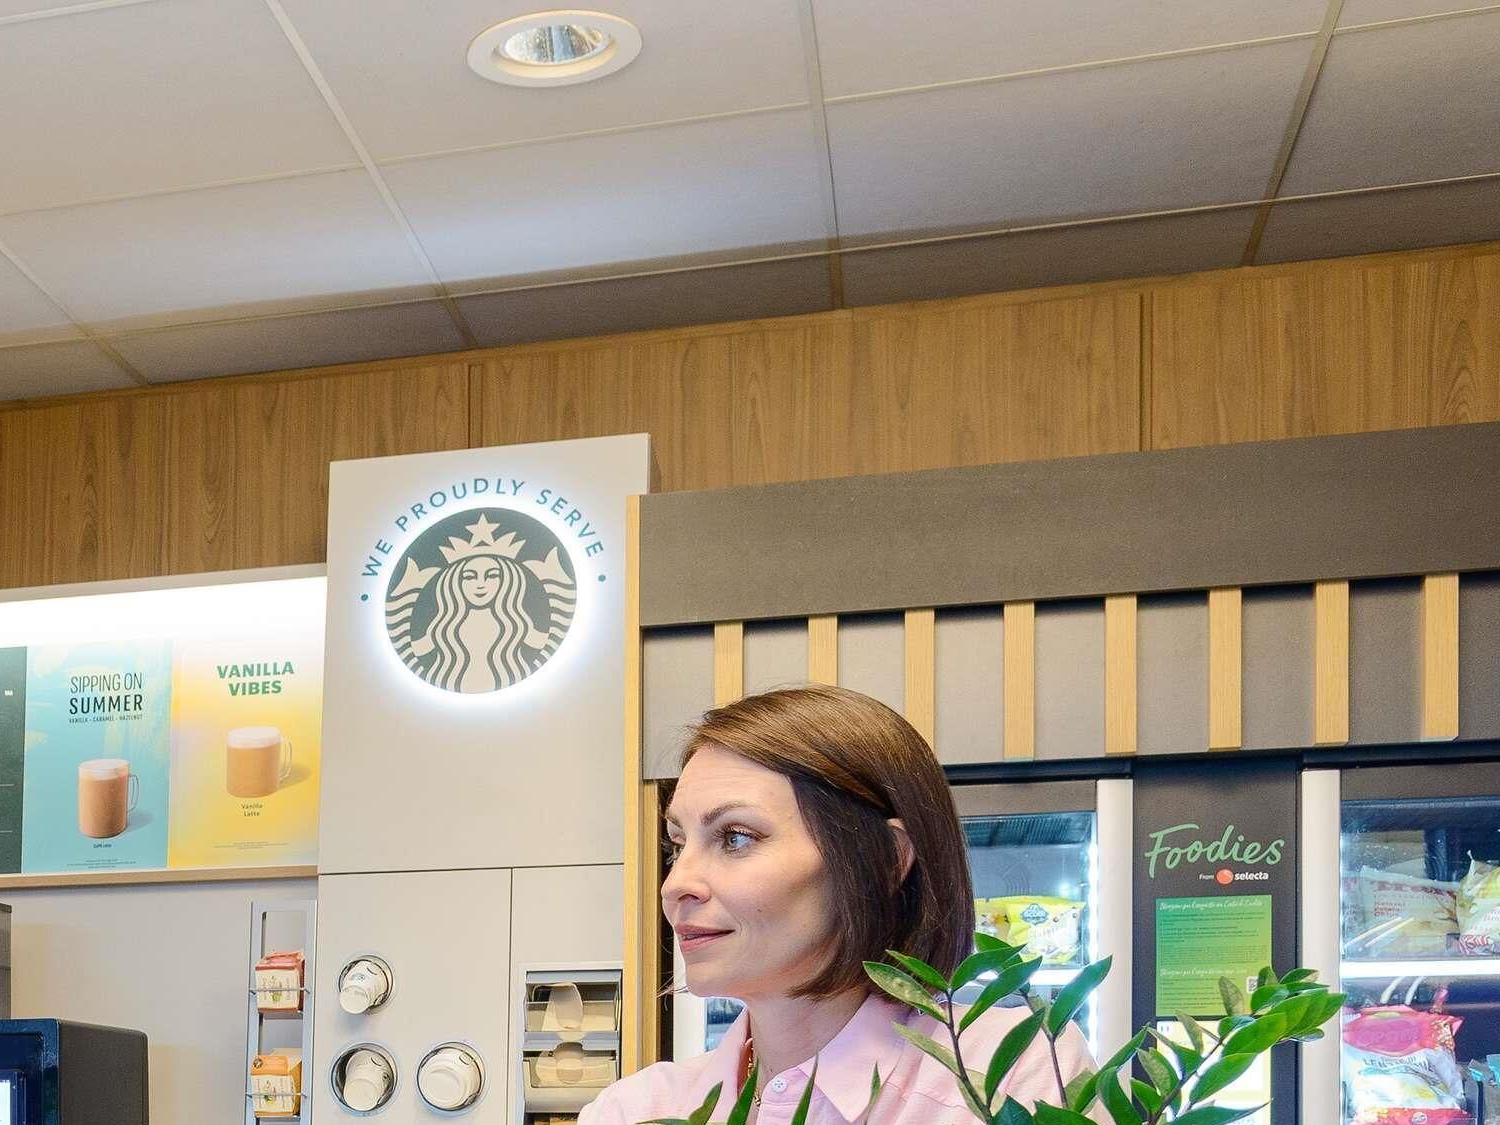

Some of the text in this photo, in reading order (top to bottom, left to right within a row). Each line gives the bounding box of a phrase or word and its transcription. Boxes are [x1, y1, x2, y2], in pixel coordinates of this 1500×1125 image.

[362, 477, 604, 577] WE PROUDLY SERVE
[216, 661, 295, 679] VANILLA
[70, 672, 143, 694] SIPPING ON
[228, 680, 282, 696] VIBES
[69, 694, 143, 715] SUMMER
[1144, 823, 1285, 879] Foodies
[1234, 871, 1269, 881] selecta
